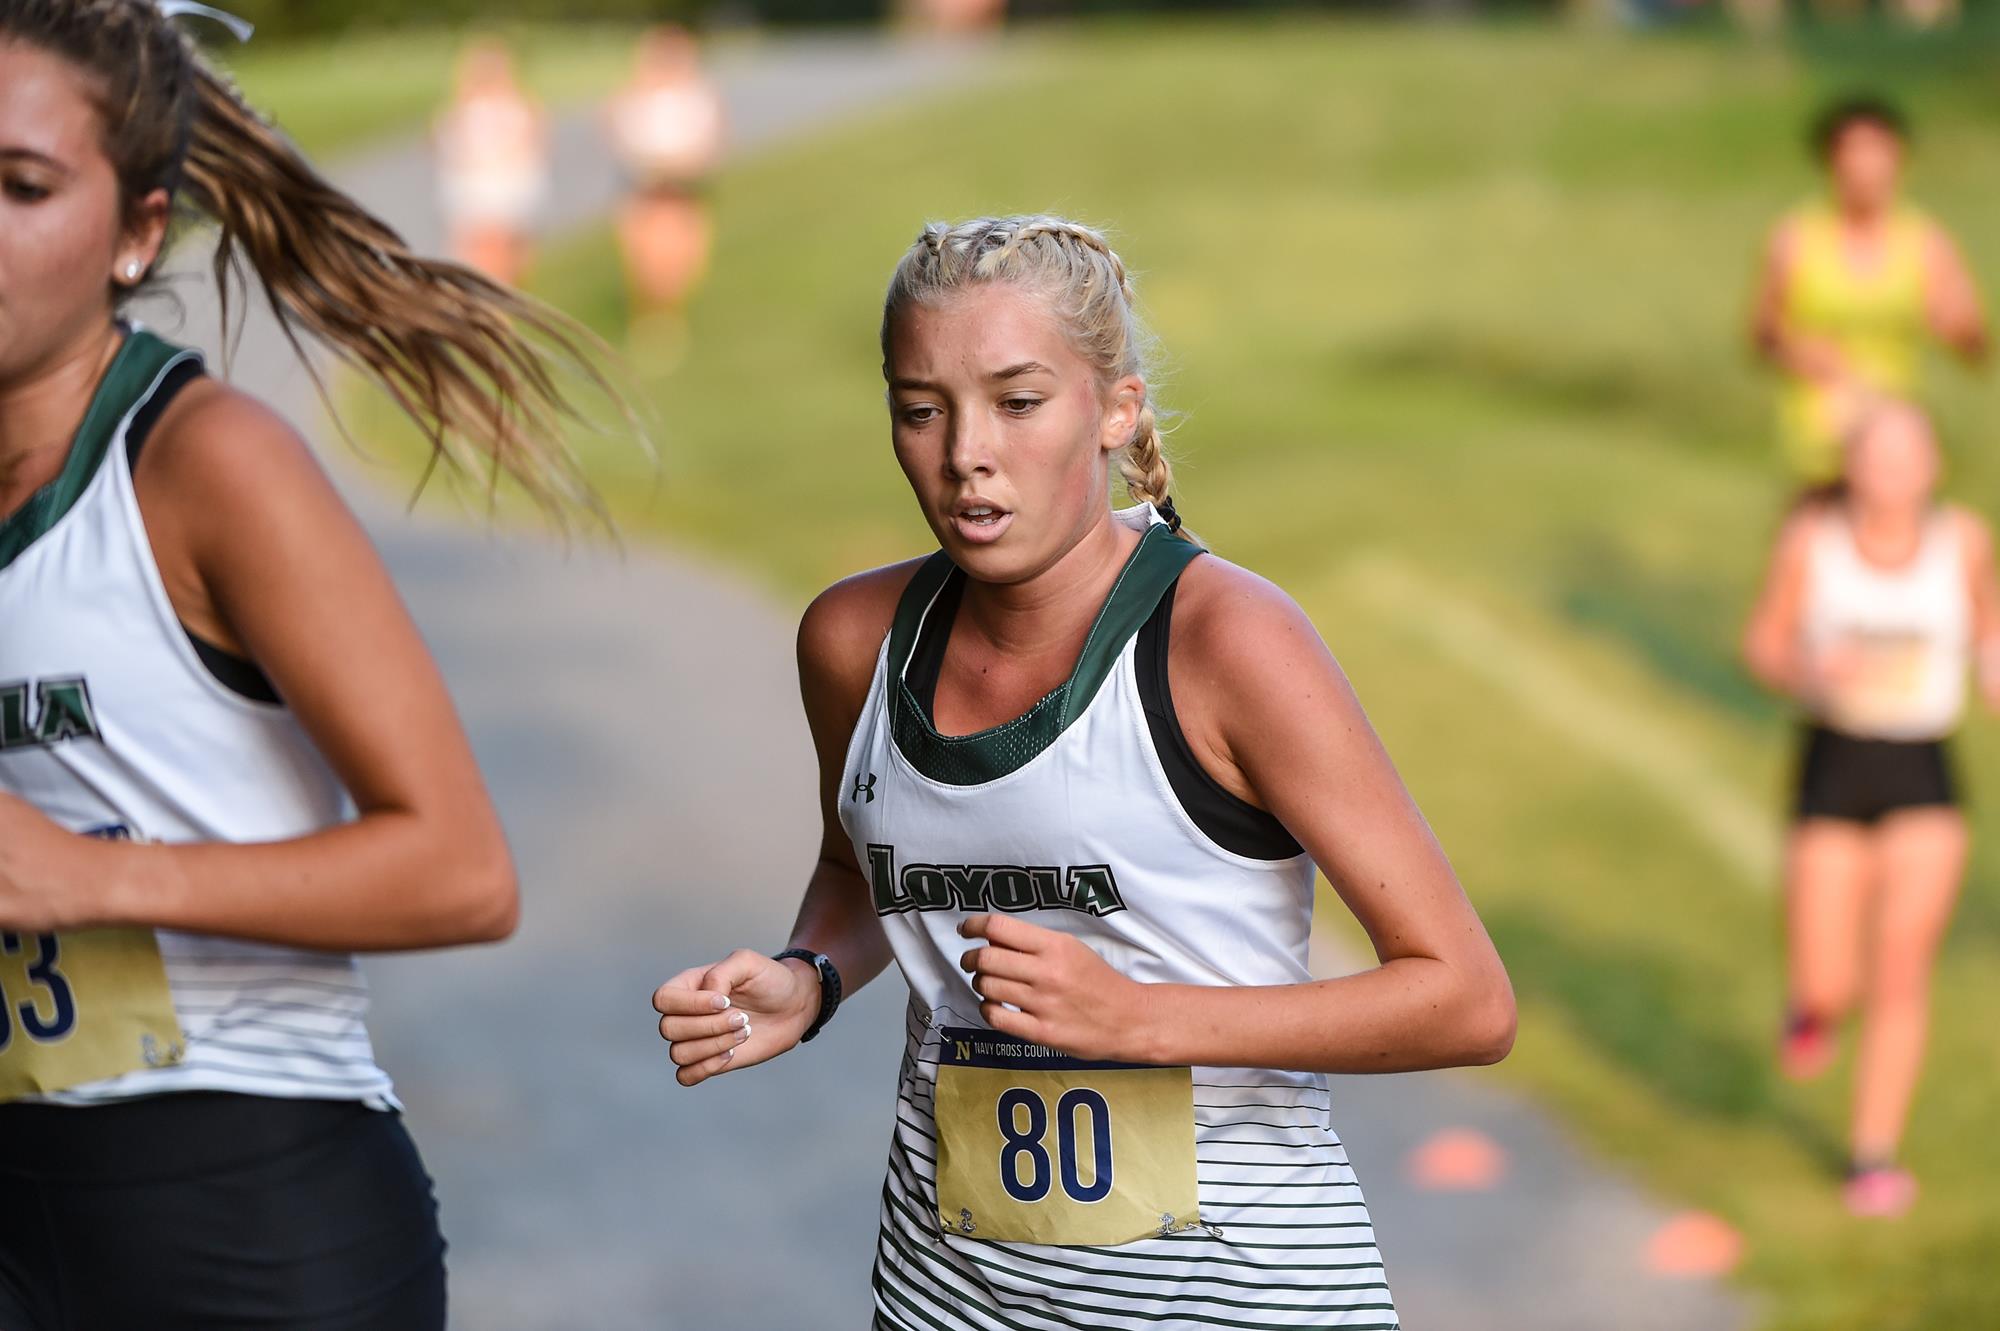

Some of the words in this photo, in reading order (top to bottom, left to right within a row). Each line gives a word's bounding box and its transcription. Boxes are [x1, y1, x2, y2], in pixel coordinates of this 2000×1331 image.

[867, 843, 1127, 917] LOYOLA
[0, 931, 79, 1054] 3
[955, 1040, 971, 1061] N
[974, 1042, 994, 1055] NAVY
[996, 1043, 1022, 1057] CROSS
[1024, 1045, 1068, 1058] COUNT
[996, 1087, 1115, 1204] 80
